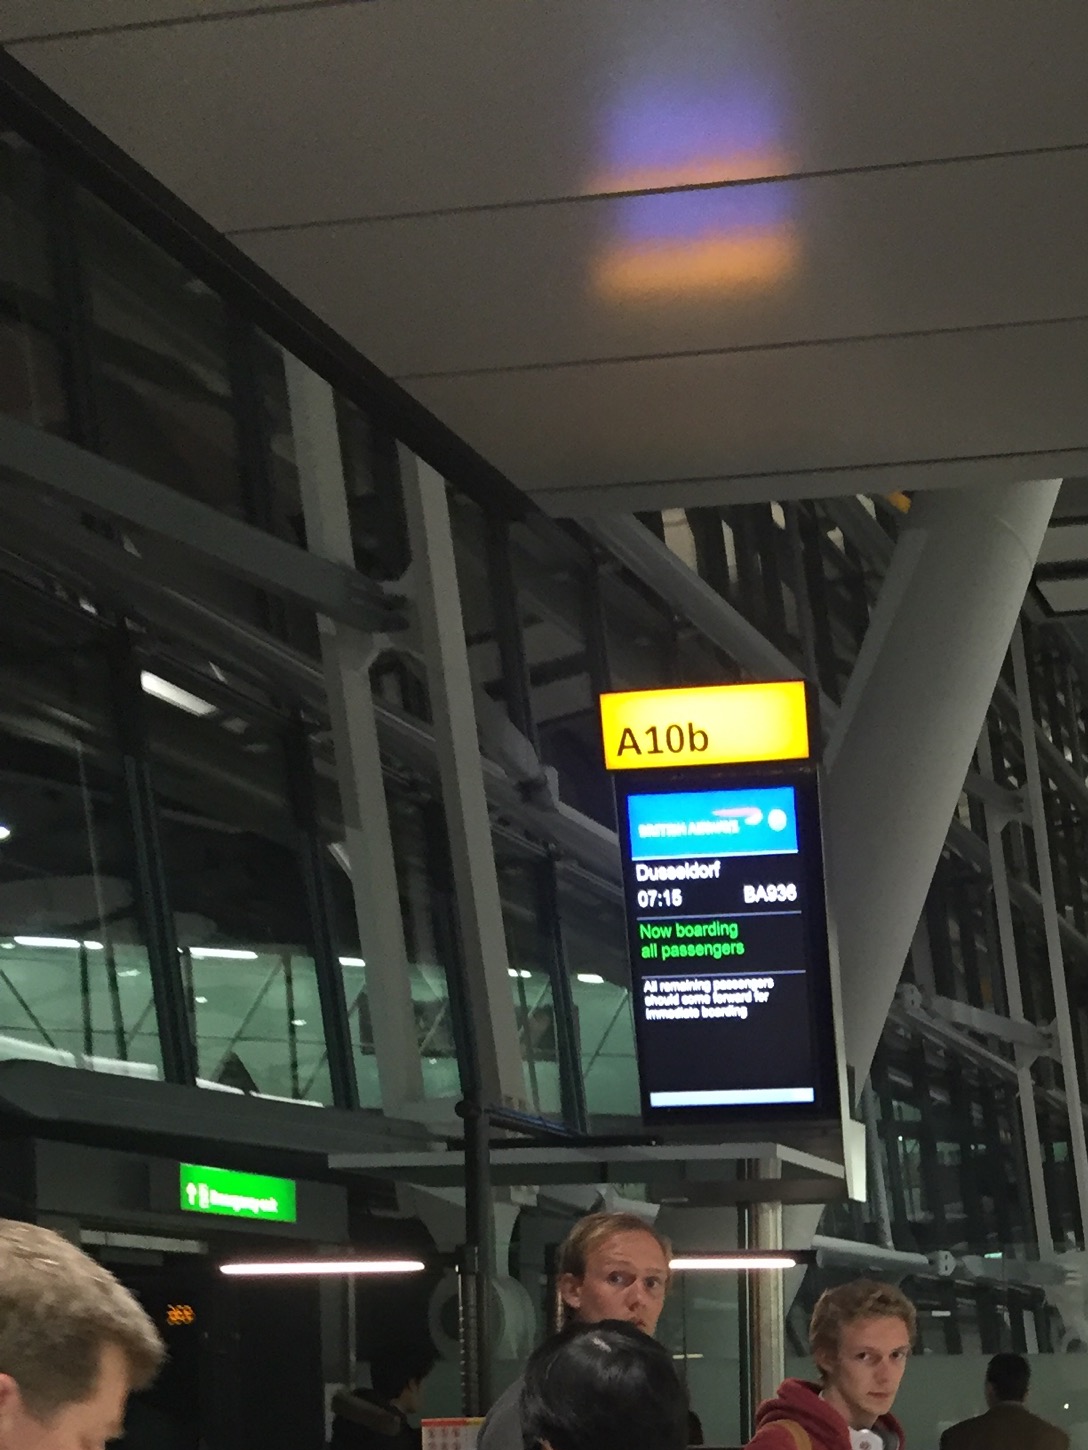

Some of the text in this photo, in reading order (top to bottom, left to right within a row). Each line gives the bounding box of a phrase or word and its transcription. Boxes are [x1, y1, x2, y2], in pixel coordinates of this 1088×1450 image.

[617, 722, 709, 757] A10b
[635, 860, 721, 882] Dusseldorf
[637, 884, 798, 908] 07:15 BA936
[640, 921, 739, 940] Now boarding
[641, 942, 745, 961] all passengers
[643, 977, 775, 994] All remaining passengers
[644, 994, 680, 1006] should
[712, 991, 752, 1004] forward
[754, 990, 770, 1003] for
